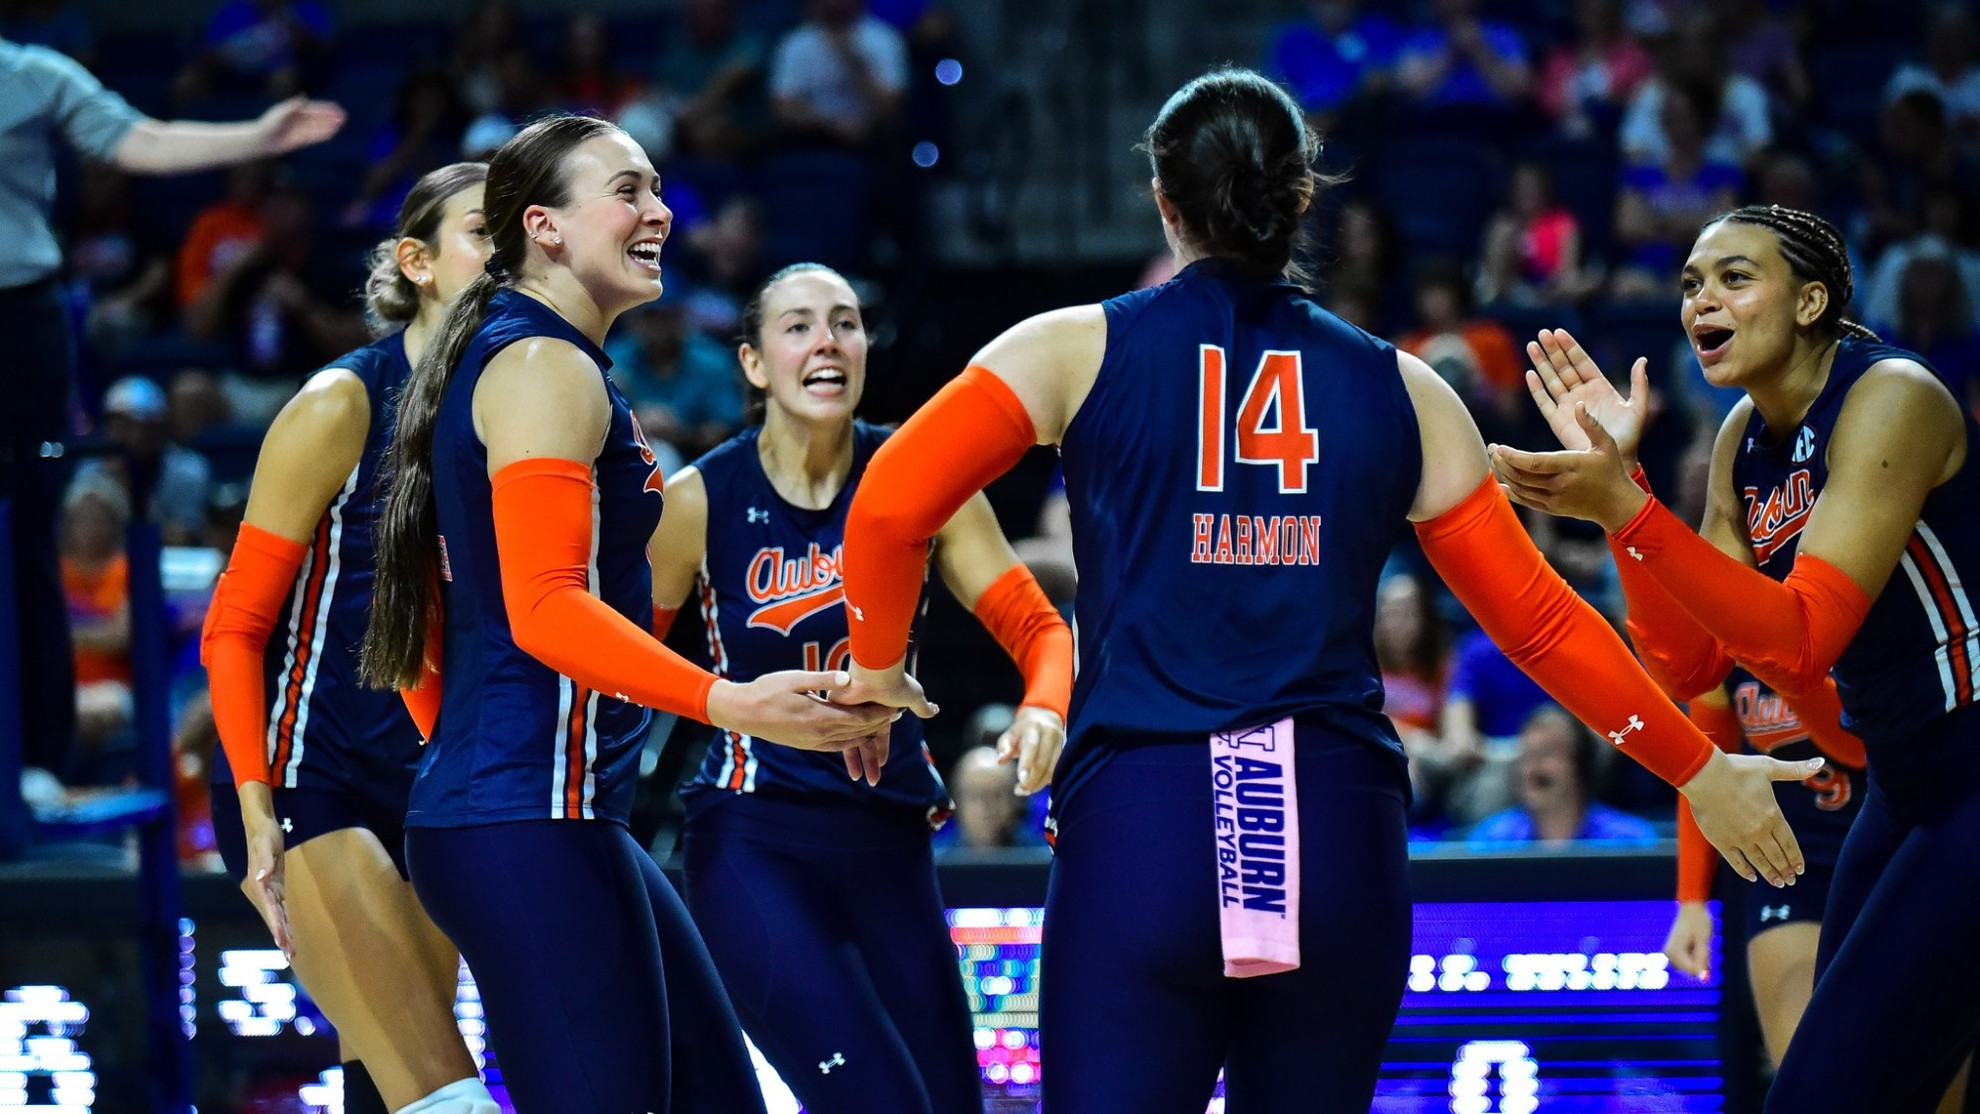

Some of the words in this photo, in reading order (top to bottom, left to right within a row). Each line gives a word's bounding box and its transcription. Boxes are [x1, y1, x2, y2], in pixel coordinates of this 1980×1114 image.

[1196, 343, 1319, 494] 14
[1191, 513, 1321, 566] HARMON
[1213, 755, 1240, 909] VOLLEYBALL
[1234, 756, 1286, 914] AUBURN
